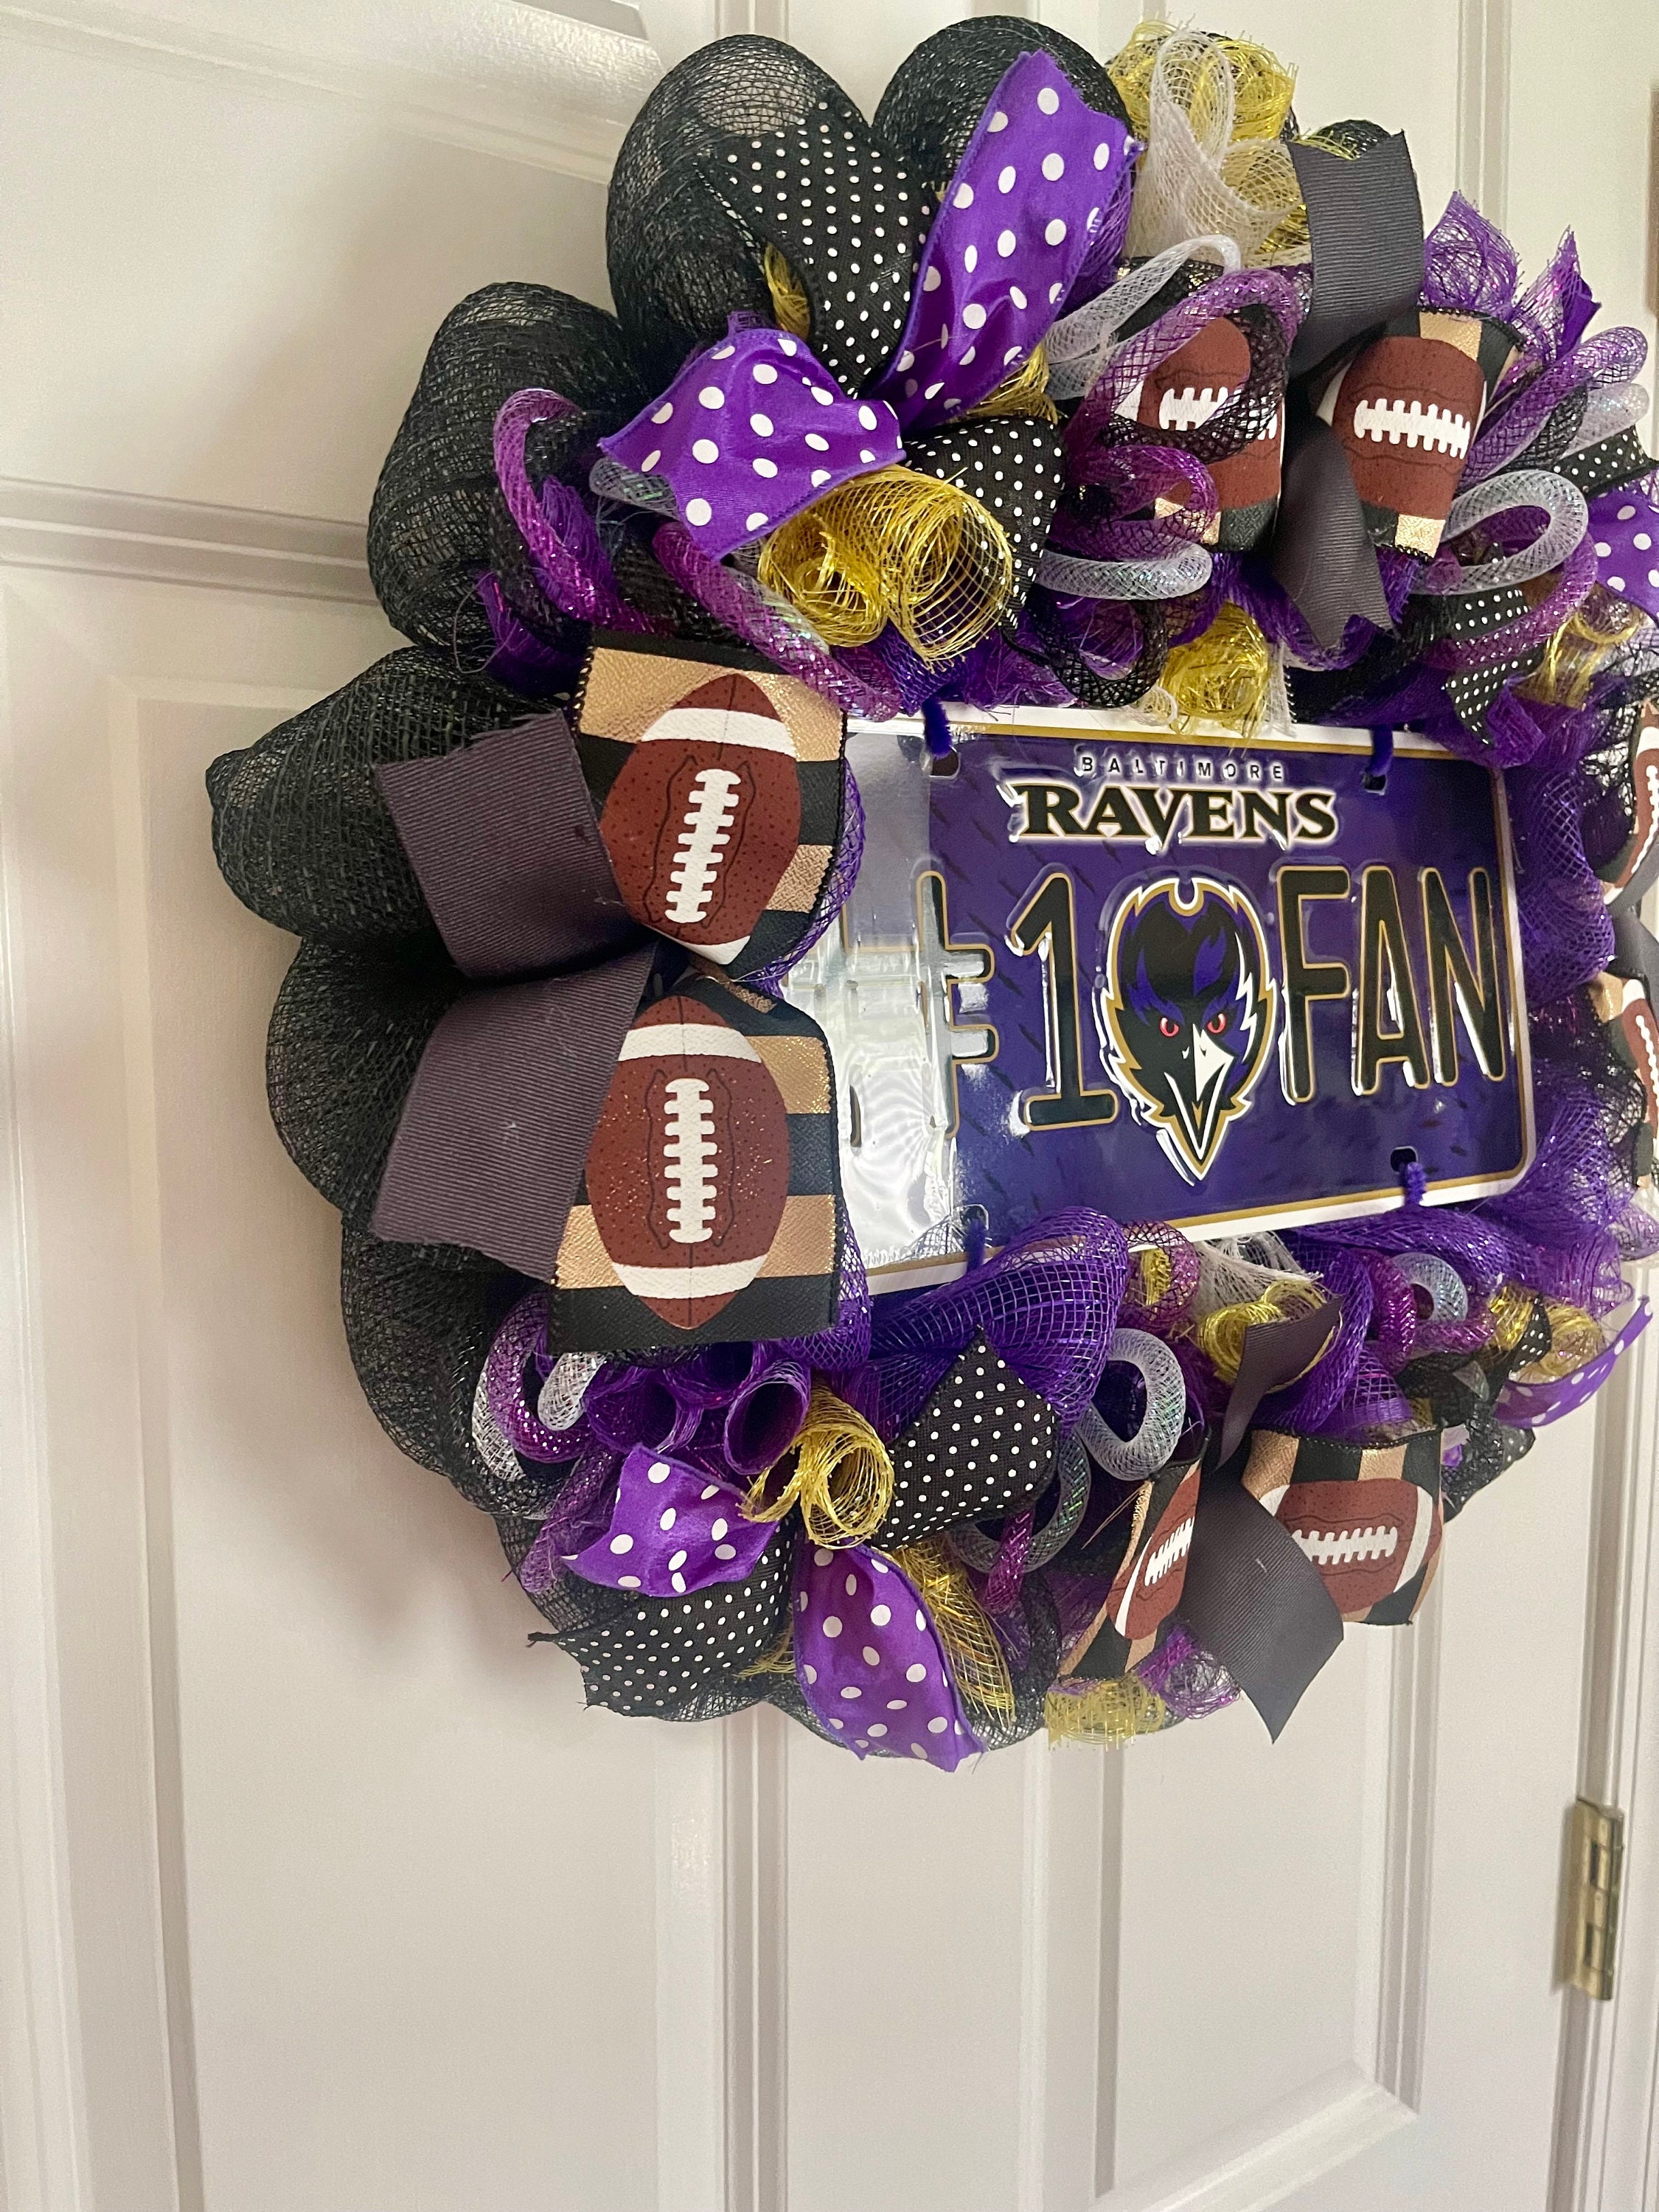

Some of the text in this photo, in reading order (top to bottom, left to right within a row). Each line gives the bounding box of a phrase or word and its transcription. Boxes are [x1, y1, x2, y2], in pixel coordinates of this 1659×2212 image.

[1082, 756, 1284, 779] BALTIMORE
[1008, 782, 1339, 852] RAVENS
[1277, 865, 1506, 1103] FAN
